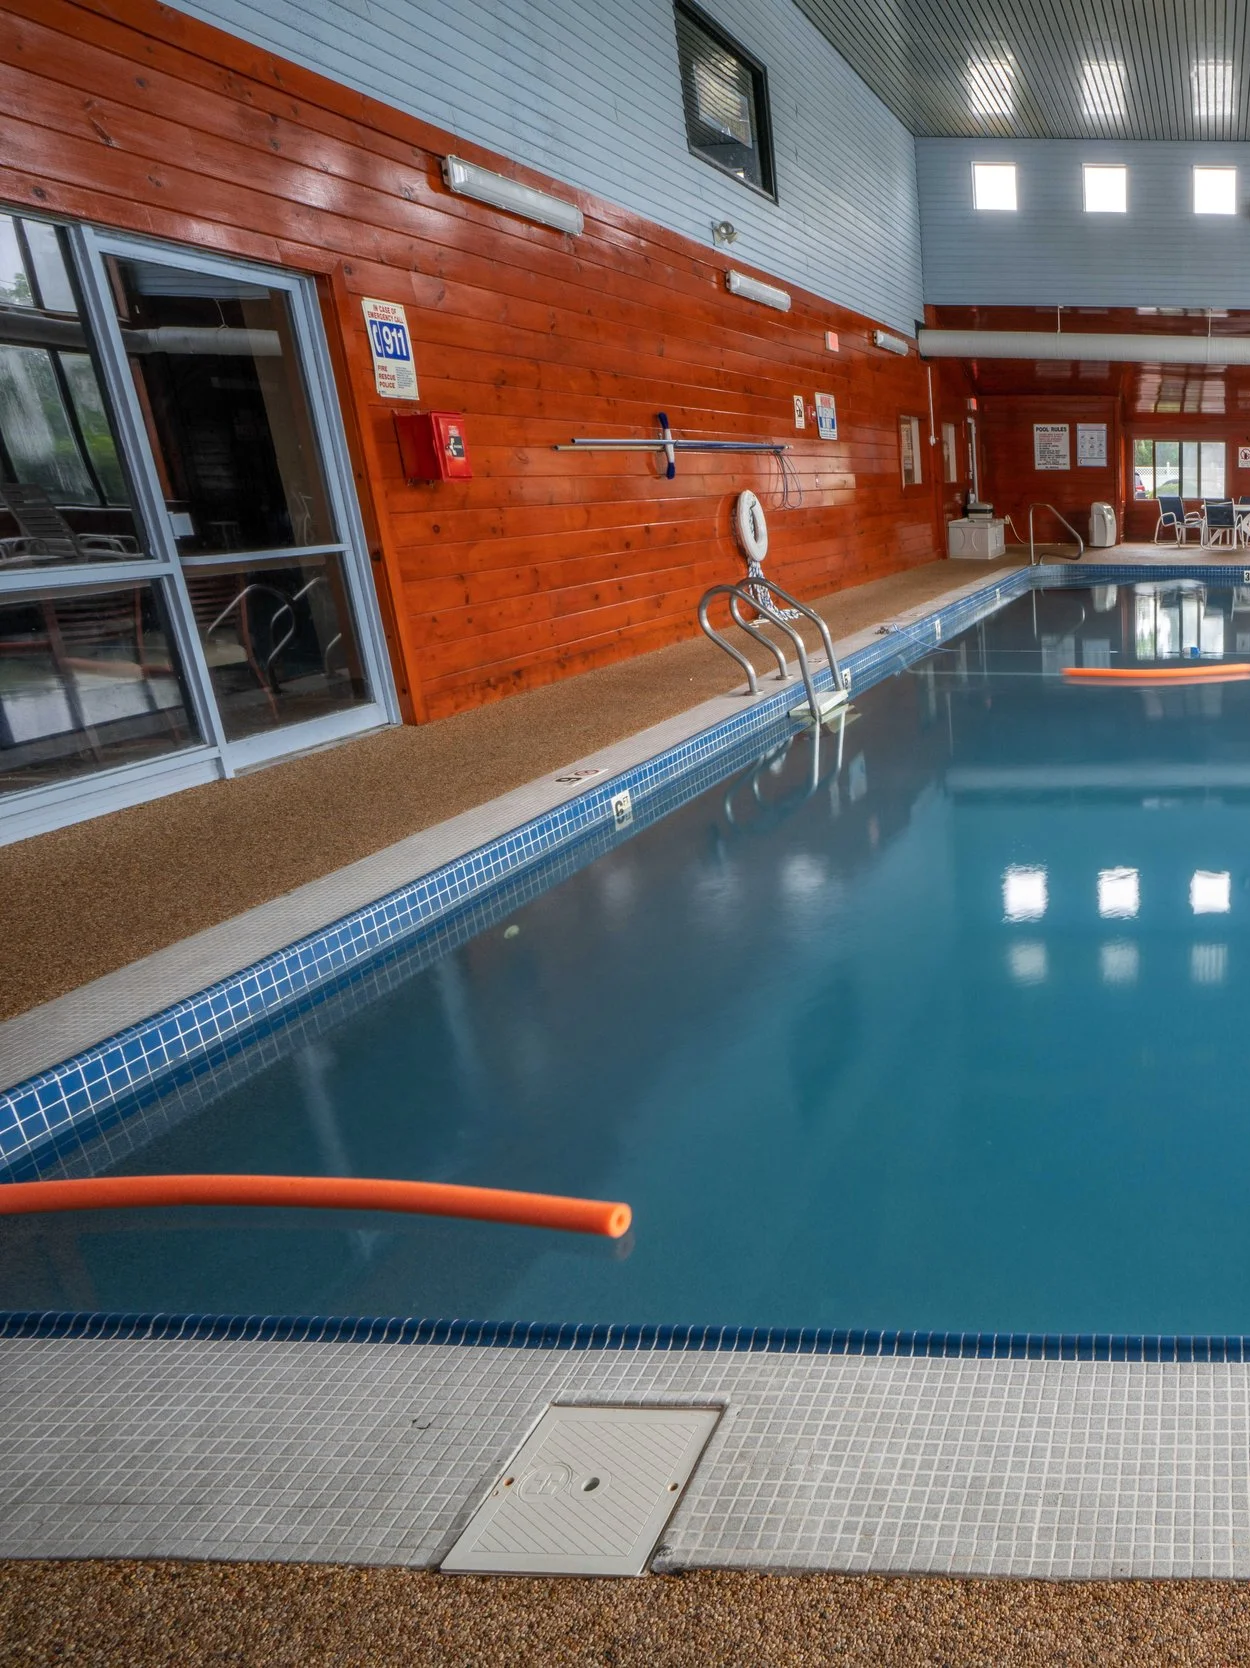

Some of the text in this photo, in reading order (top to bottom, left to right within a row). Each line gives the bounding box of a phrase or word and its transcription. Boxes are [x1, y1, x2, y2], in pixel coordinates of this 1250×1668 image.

[379, 305, 391, 314] CASE
[391, 307, 397, 315] OF
[367, 311, 405, 324] EMERGENCY CALL
[382, 326, 407, 356] 911
[1245, 572, 1250, 581] 3
